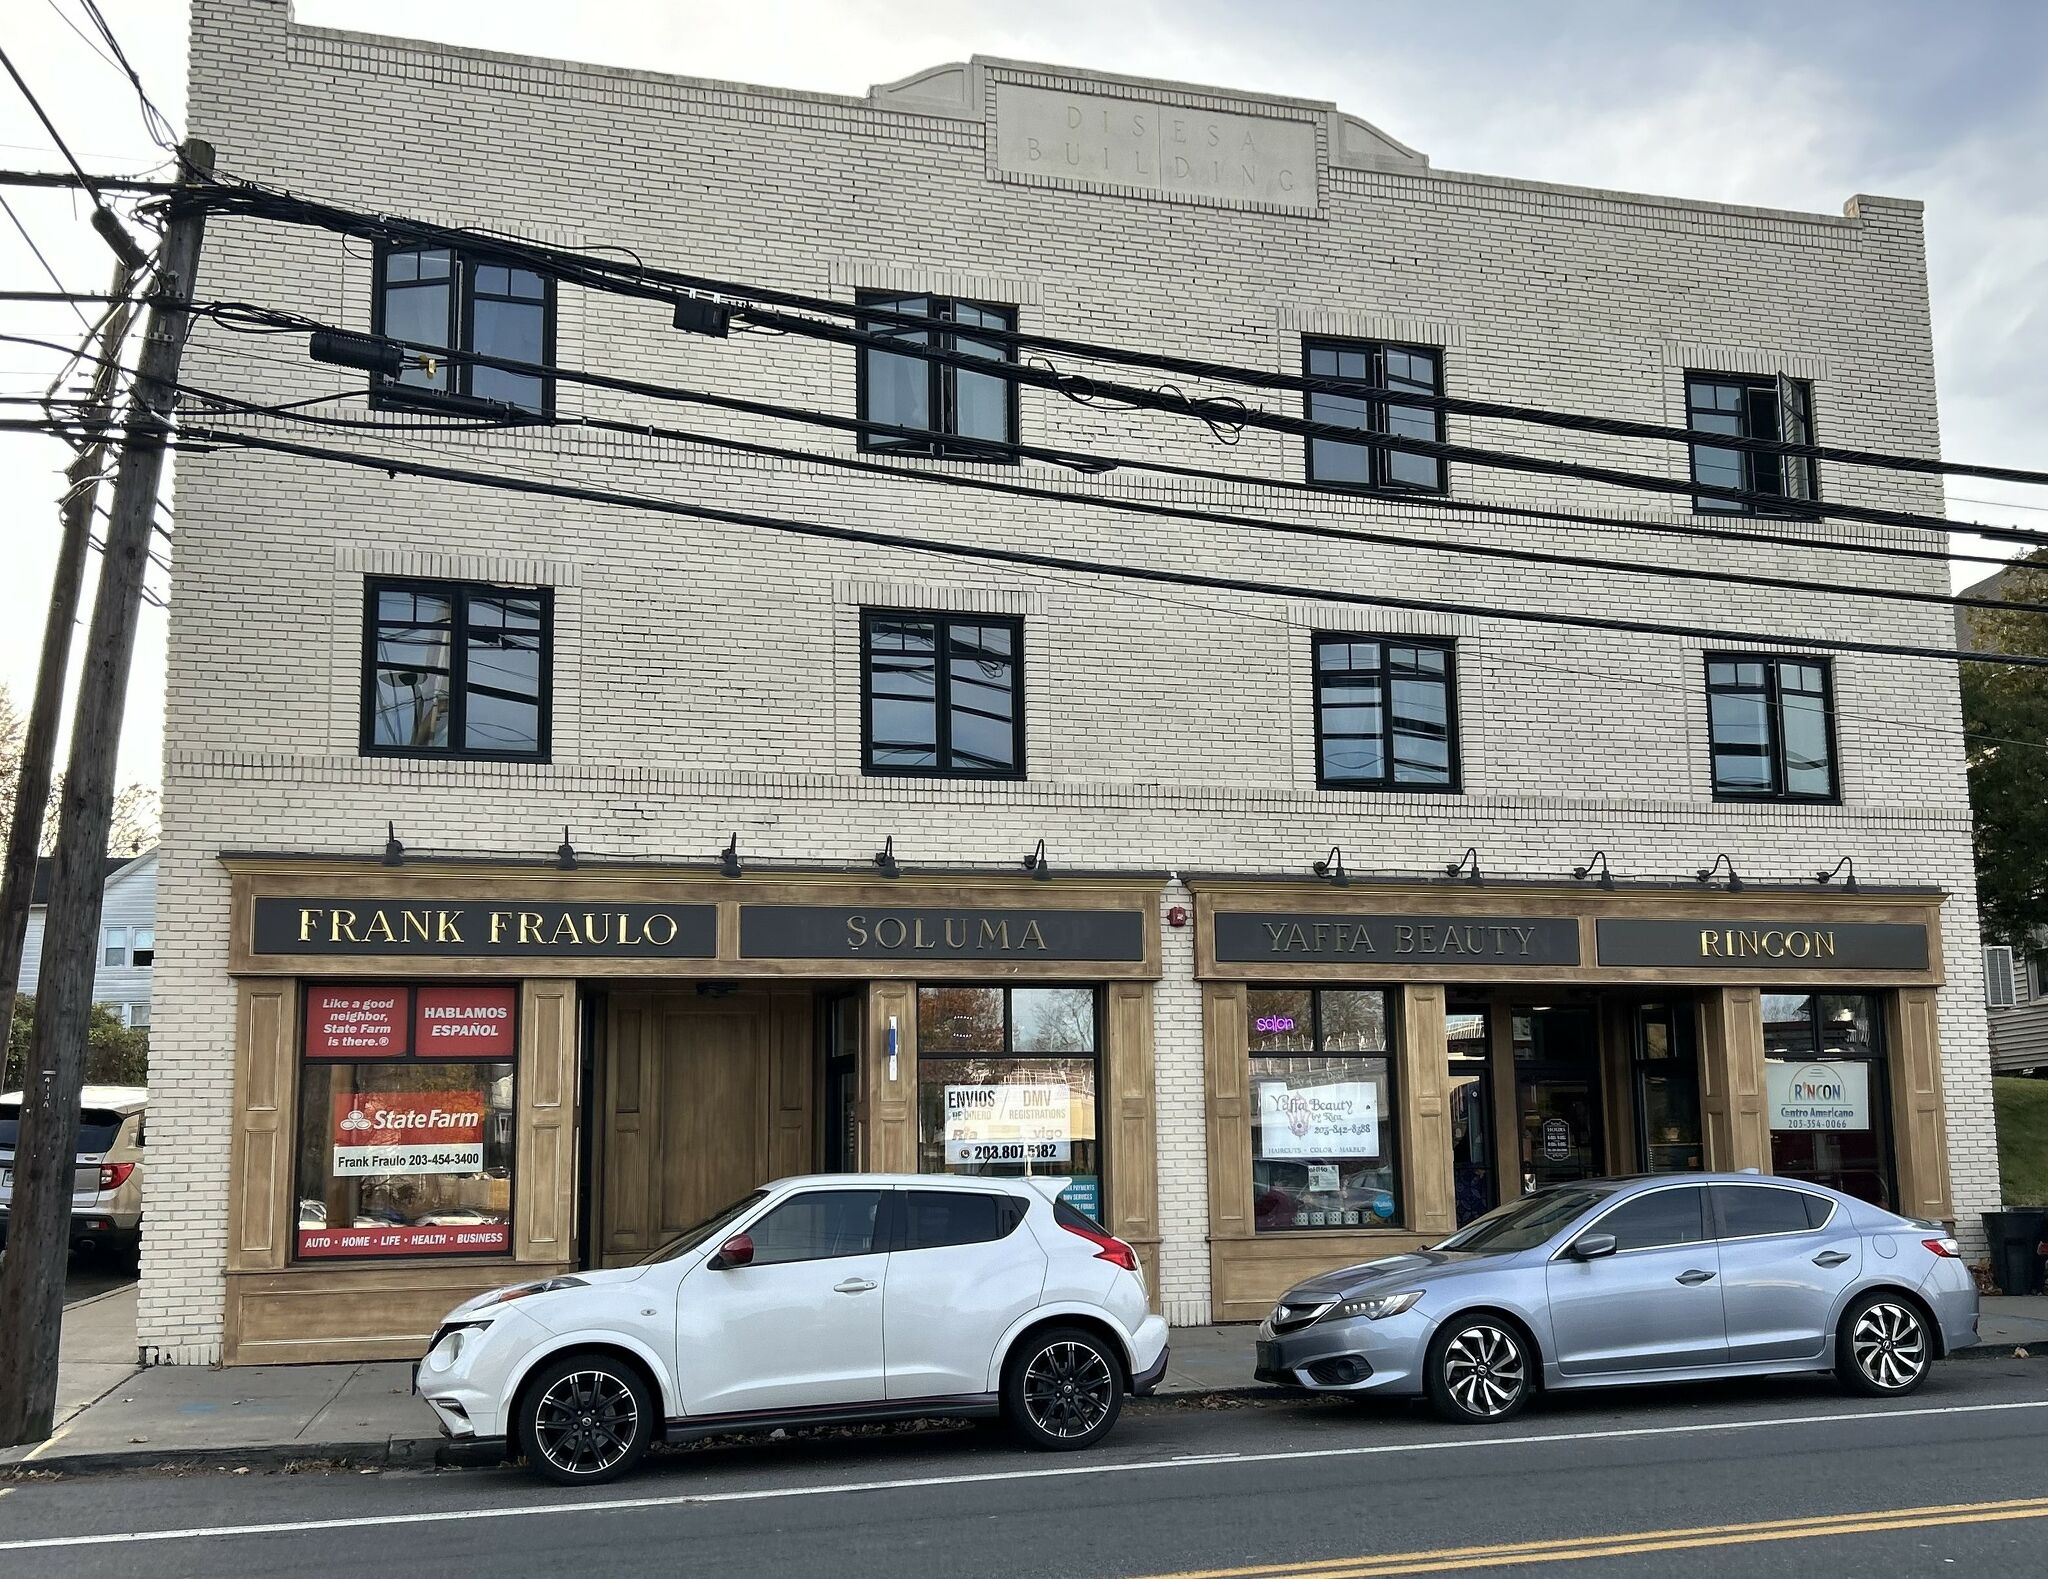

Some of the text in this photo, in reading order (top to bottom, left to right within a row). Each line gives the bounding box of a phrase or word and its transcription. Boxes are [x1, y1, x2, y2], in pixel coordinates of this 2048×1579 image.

[1066, 105, 1257, 153] DISESA
[1026, 136, 1295, 193] BUILDING
[297, 907, 679, 946] FRANK FRAULO
[846, 915, 1049, 951] SOLUMA
[1262, 922, 1536, 955] YAFFA BEAUTY
[1700, 929, 1836, 958] RINCON
[322, 998, 395, 1010] Like a good
[330, 1010, 389, 1023] neighbor,
[424, 1007, 508, 1019] HABLAMOS
[323, 1023, 392, 1034] State Farm
[431, 1022, 500, 1037] ESPAÑOL
[1256, 1014, 1296, 1033] salon
[327, 1036, 340, 1047] is
[1023, 1090, 1052, 1107] DMV
[1794, 1082, 1842, 1100] RINCON
[948, 1089, 996, 1109] ENVIOS
[1270, 1094, 1354, 1115] Yaffa Beauty
[952, 1110, 992, 1121] DE DINERO
[1009, 1108, 1067, 1121] REGISTRATIONS
[1780, 1106, 1854, 1118] Centro Americano
[1788, 1119, 1847, 1128] 203-354-0066
[952, 1126, 979, 1141] Ria
[1033, 1126, 1063, 1140] vigo
[974, 1143, 1057, 1160] 203.8075182
[1309, 1146, 1333, 1154] COLOR
[338, 1153, 480, 1168] Frank Fraulo 203-454-3400
[305, 1232, 503, 1248] AUTO HOME LIFE HEALTH BUSINESS
